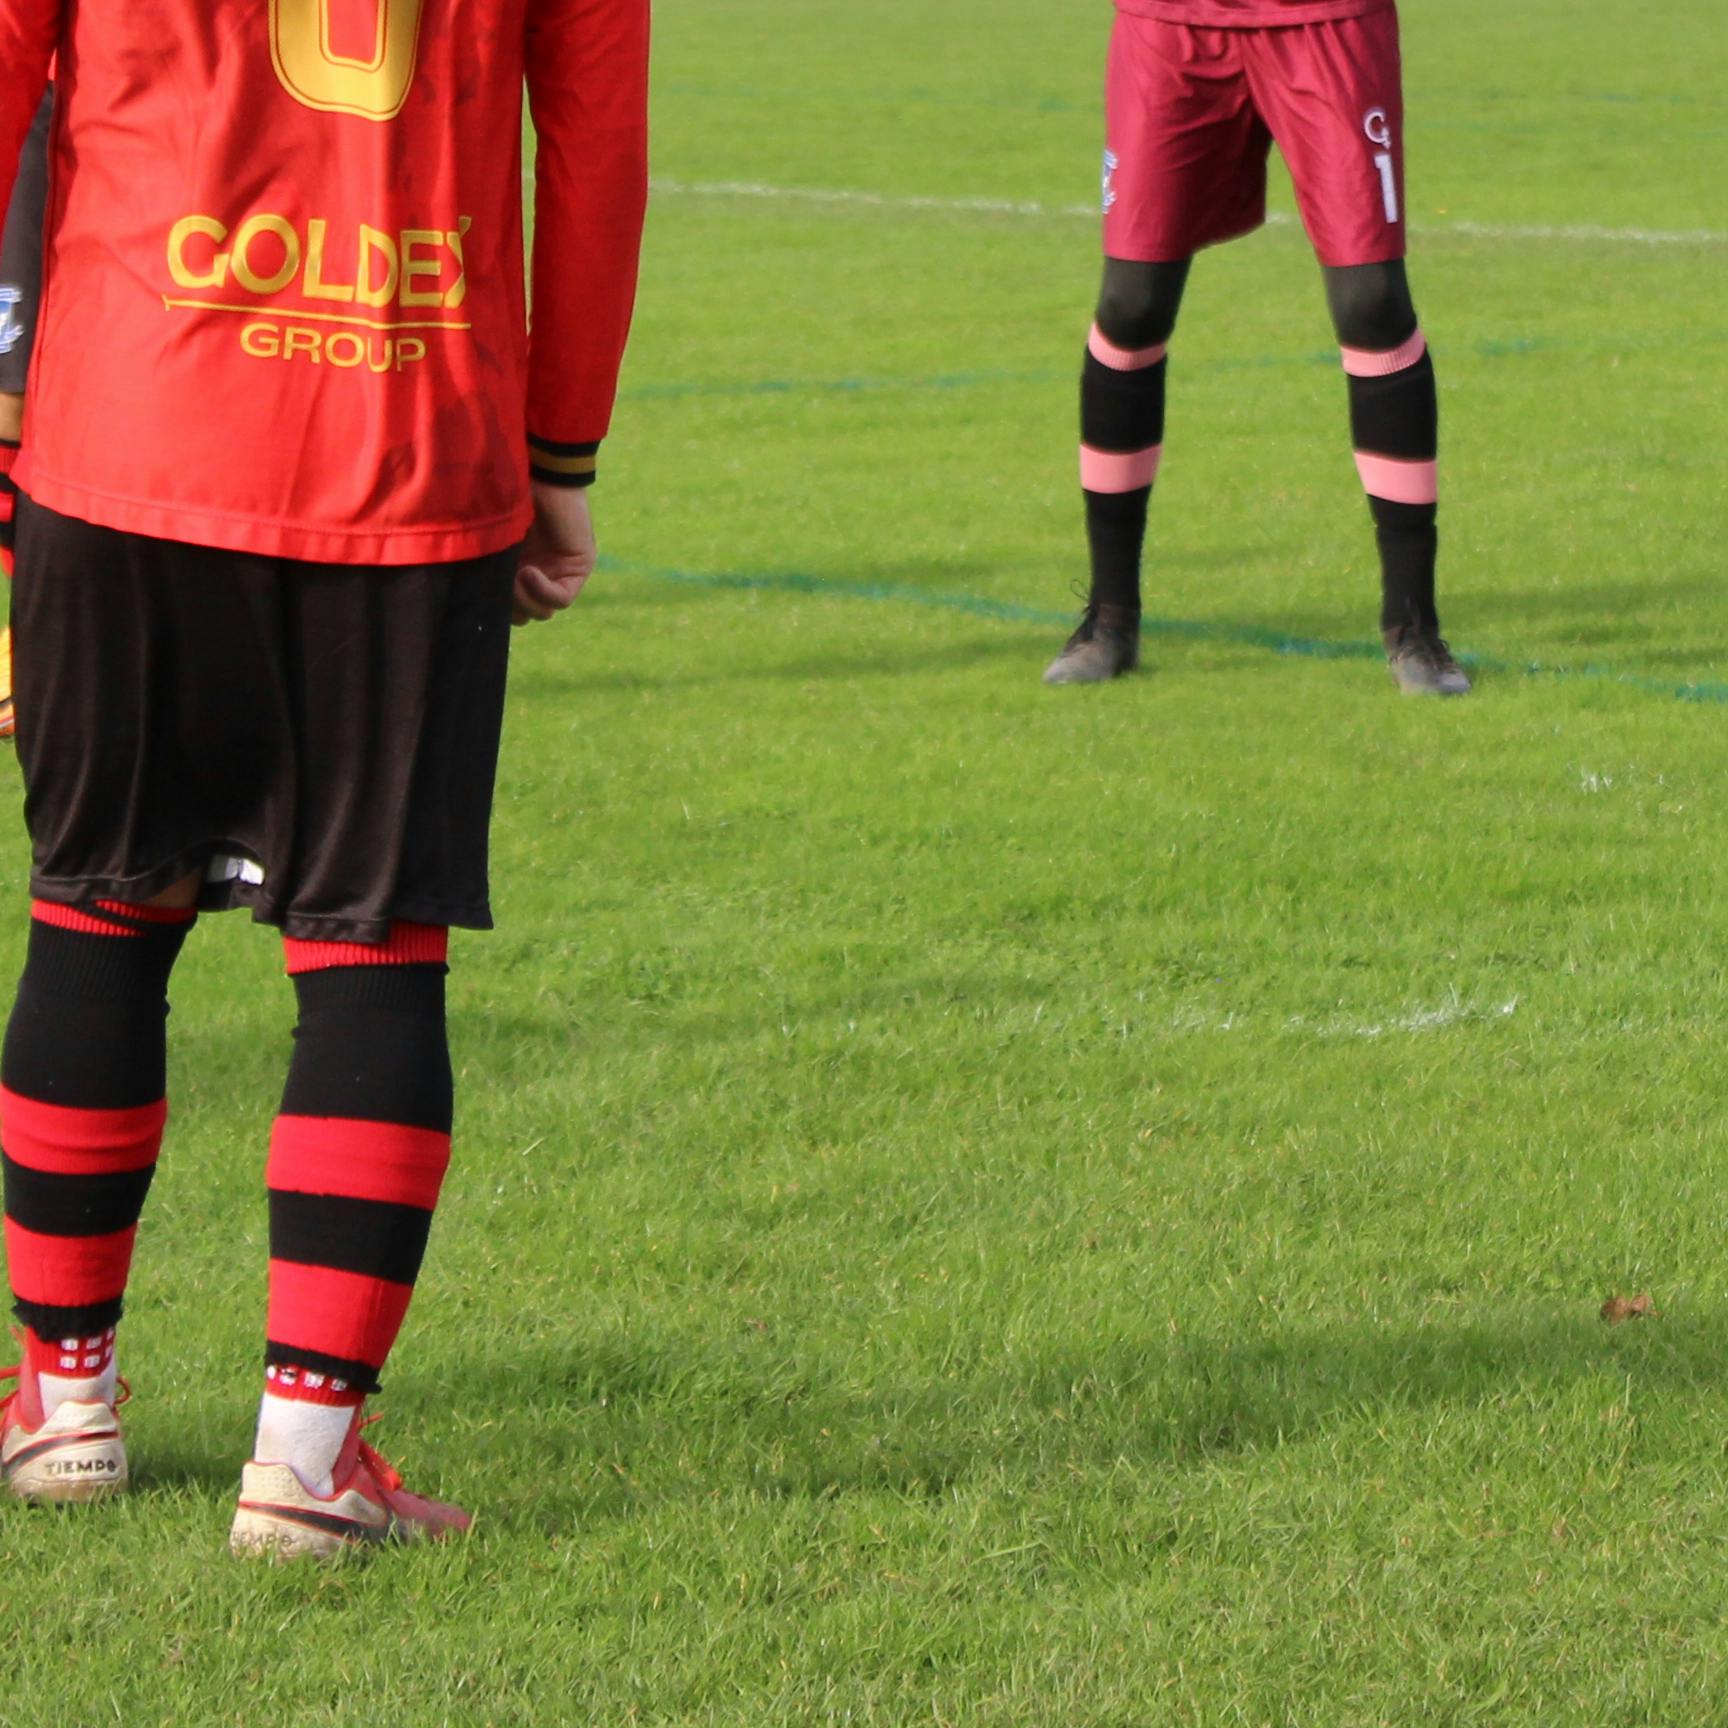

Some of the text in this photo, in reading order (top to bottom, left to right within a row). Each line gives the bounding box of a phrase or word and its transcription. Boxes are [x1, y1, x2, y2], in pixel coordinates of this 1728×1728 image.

[1375, 154, 1398, 224] 1
[167, 214, 472, 309] GOLDEX
[240, 323, 426, 373] GROUP
